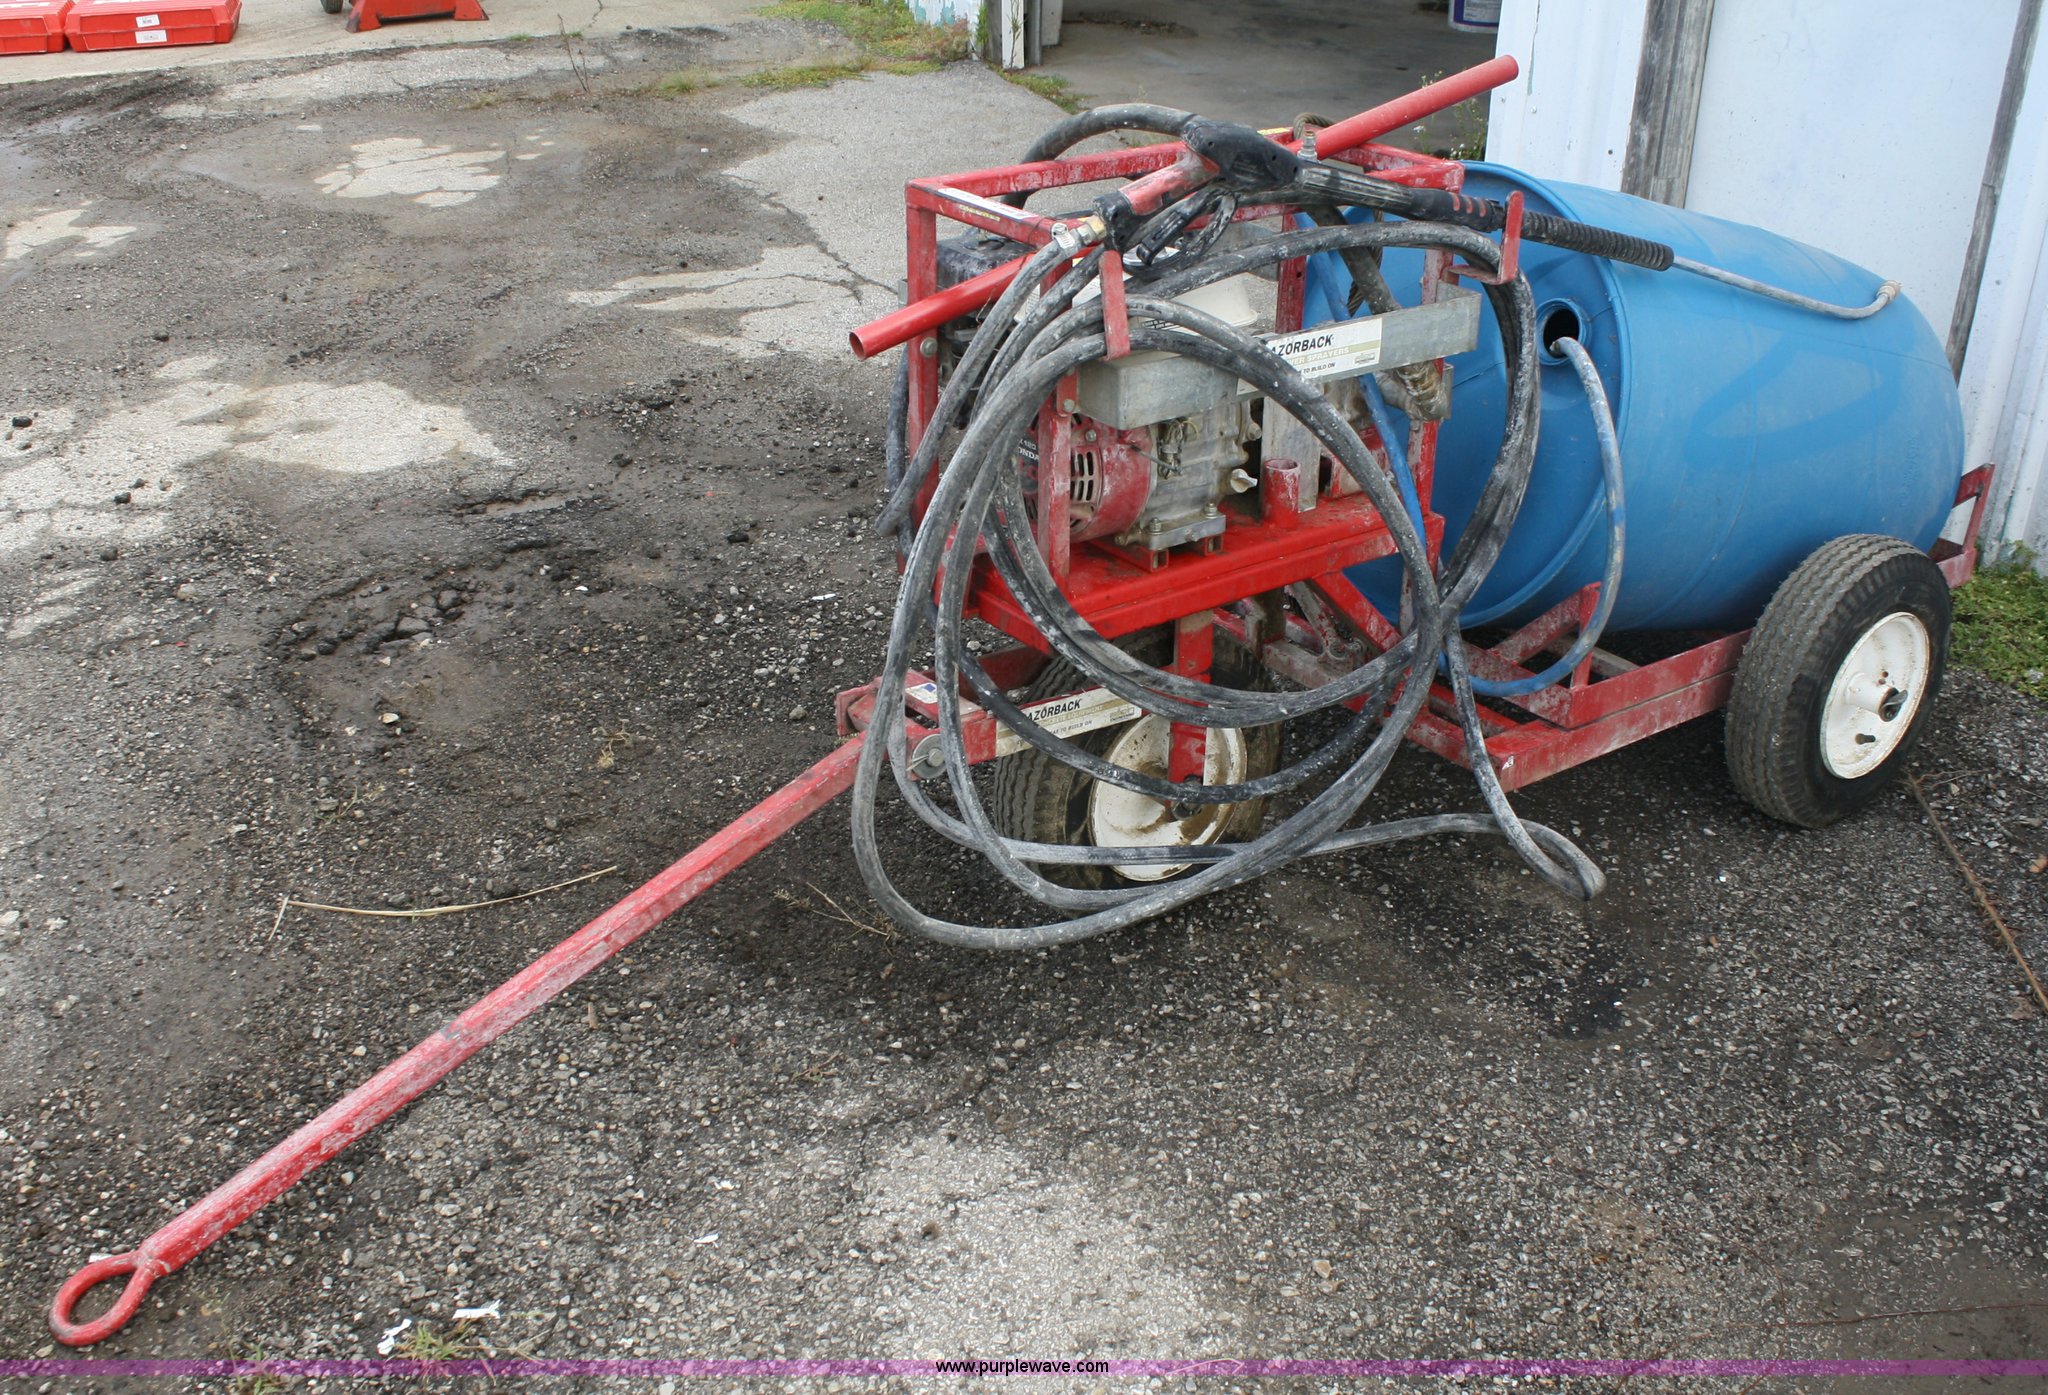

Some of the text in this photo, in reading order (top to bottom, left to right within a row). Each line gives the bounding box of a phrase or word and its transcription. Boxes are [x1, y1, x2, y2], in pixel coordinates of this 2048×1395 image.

[1272, 334, 1333, 356] AZORBACK
[1306, 347, 1350, 361] SPRAYERS
[1027, 699, 1082, 721] AZORBACK
